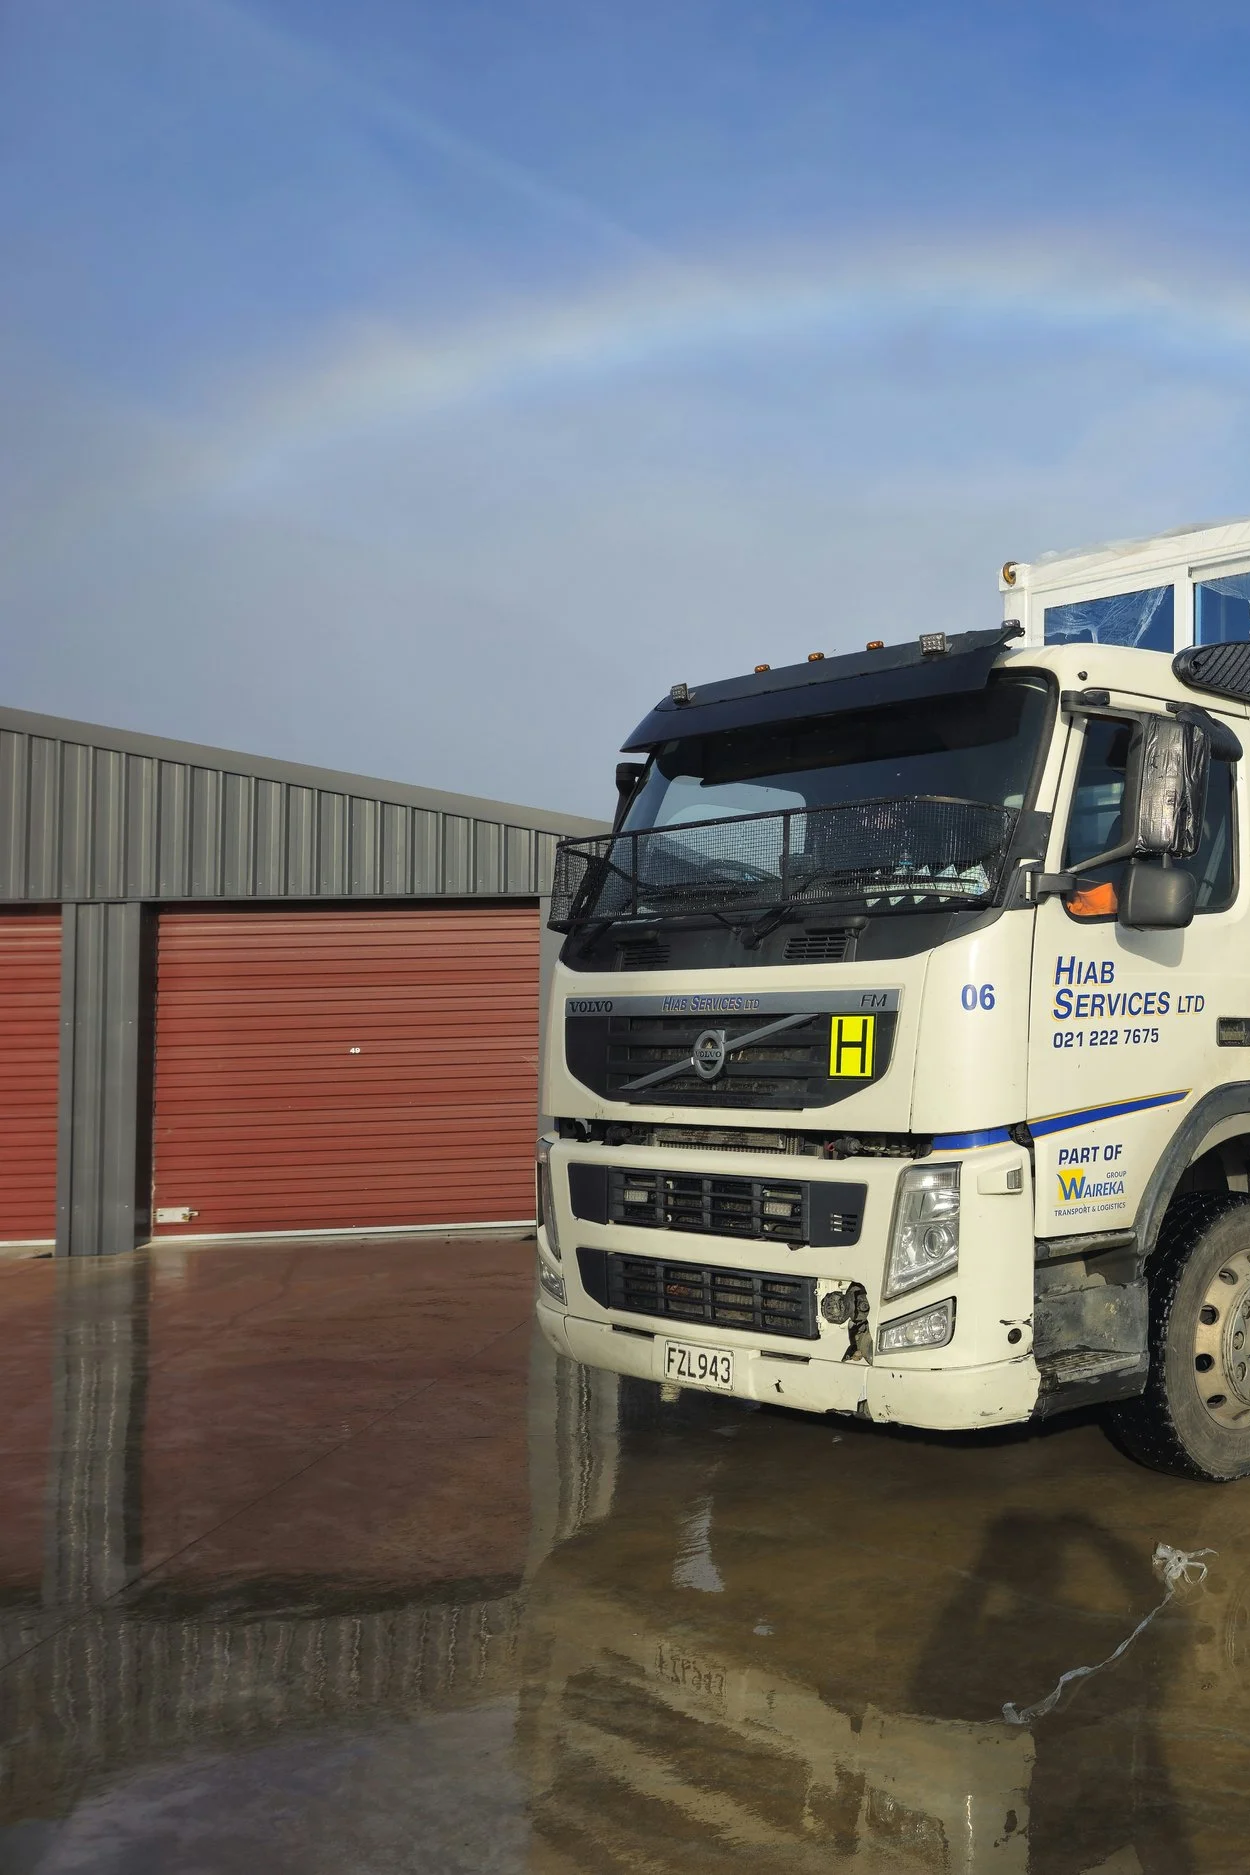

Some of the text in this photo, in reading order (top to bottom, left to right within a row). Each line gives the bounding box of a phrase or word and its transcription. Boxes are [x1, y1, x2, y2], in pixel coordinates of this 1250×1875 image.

[568, 1000, 613, 1012] VOLVO
[744, 999, 759, 1010] LTD
[861, 994, 888, 1007] FM
[961, 984, 996, 1011] 06
[1177, 995, 1205, 1014] LTD
[836, 1019, 867, 1073] H
[1053, 1028, 1159, 1048] 021 222 7675
[1058, 1144, 1122, 1165] PART OF
[1056, 1173, 1124, 1200] WAIREKA
[1054, 1206, 1090, 1216] TRANSPORT
[1097, 1202, 1126, 1212] LOGISTICS
[667, 1347, 731, 1383] FZL943
